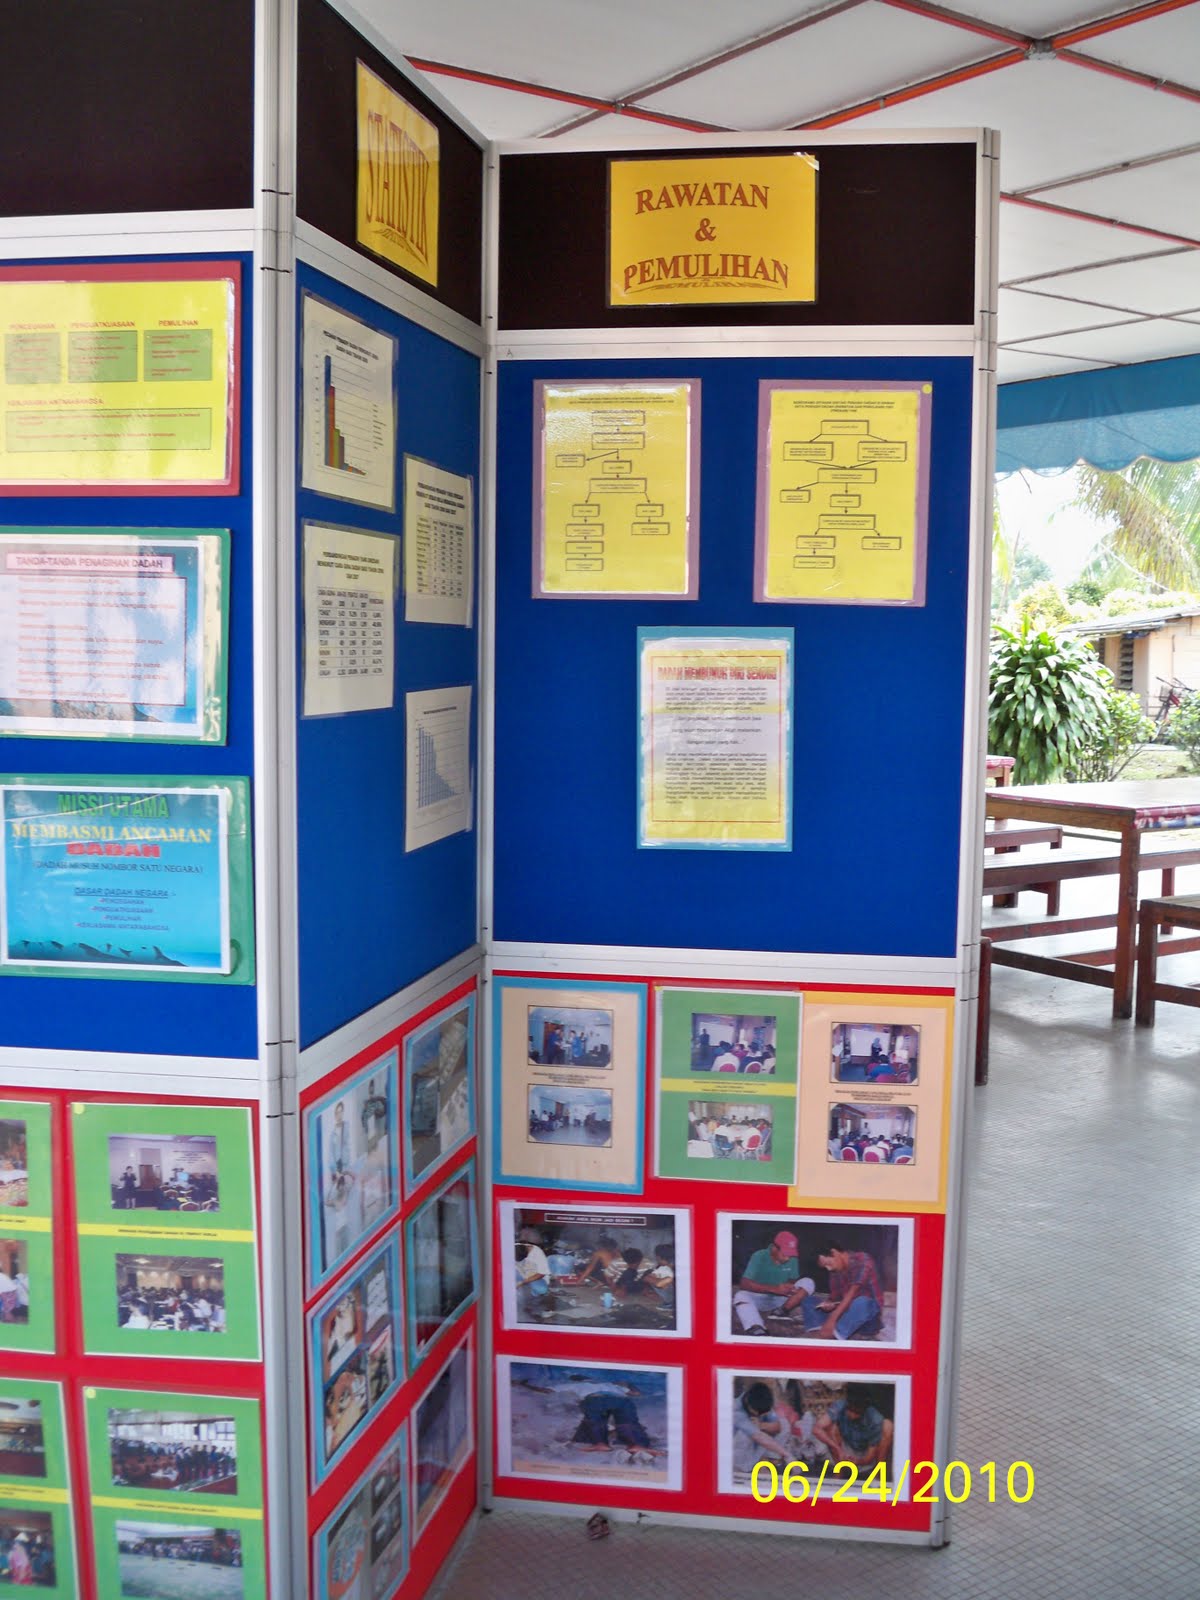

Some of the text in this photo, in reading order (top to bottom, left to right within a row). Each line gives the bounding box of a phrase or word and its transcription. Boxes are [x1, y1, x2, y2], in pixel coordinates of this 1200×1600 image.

[635, 182, 770, 215] RAWATAN
[695, 218, 716, 242] &
[624, 254, 789, 292] PEMULIHAN
[16, 556, 163, 569] TANDA-TANDA PENAGIHAN DADAH
[57, 793, 170, 819] MISSI UTAMA
[12, 822, 212, 844] MEMBASMI ANCAMAN
[66, 841, 161, 858] DADAH
[101, 863, 138, 871] NOMBOR
[139, 863, 162, 872] SATU
[74, 887, 101, 896] DASAR
[104, 888, 132, 896] DADAH
[135, 889, 169, 897] NEGARA
